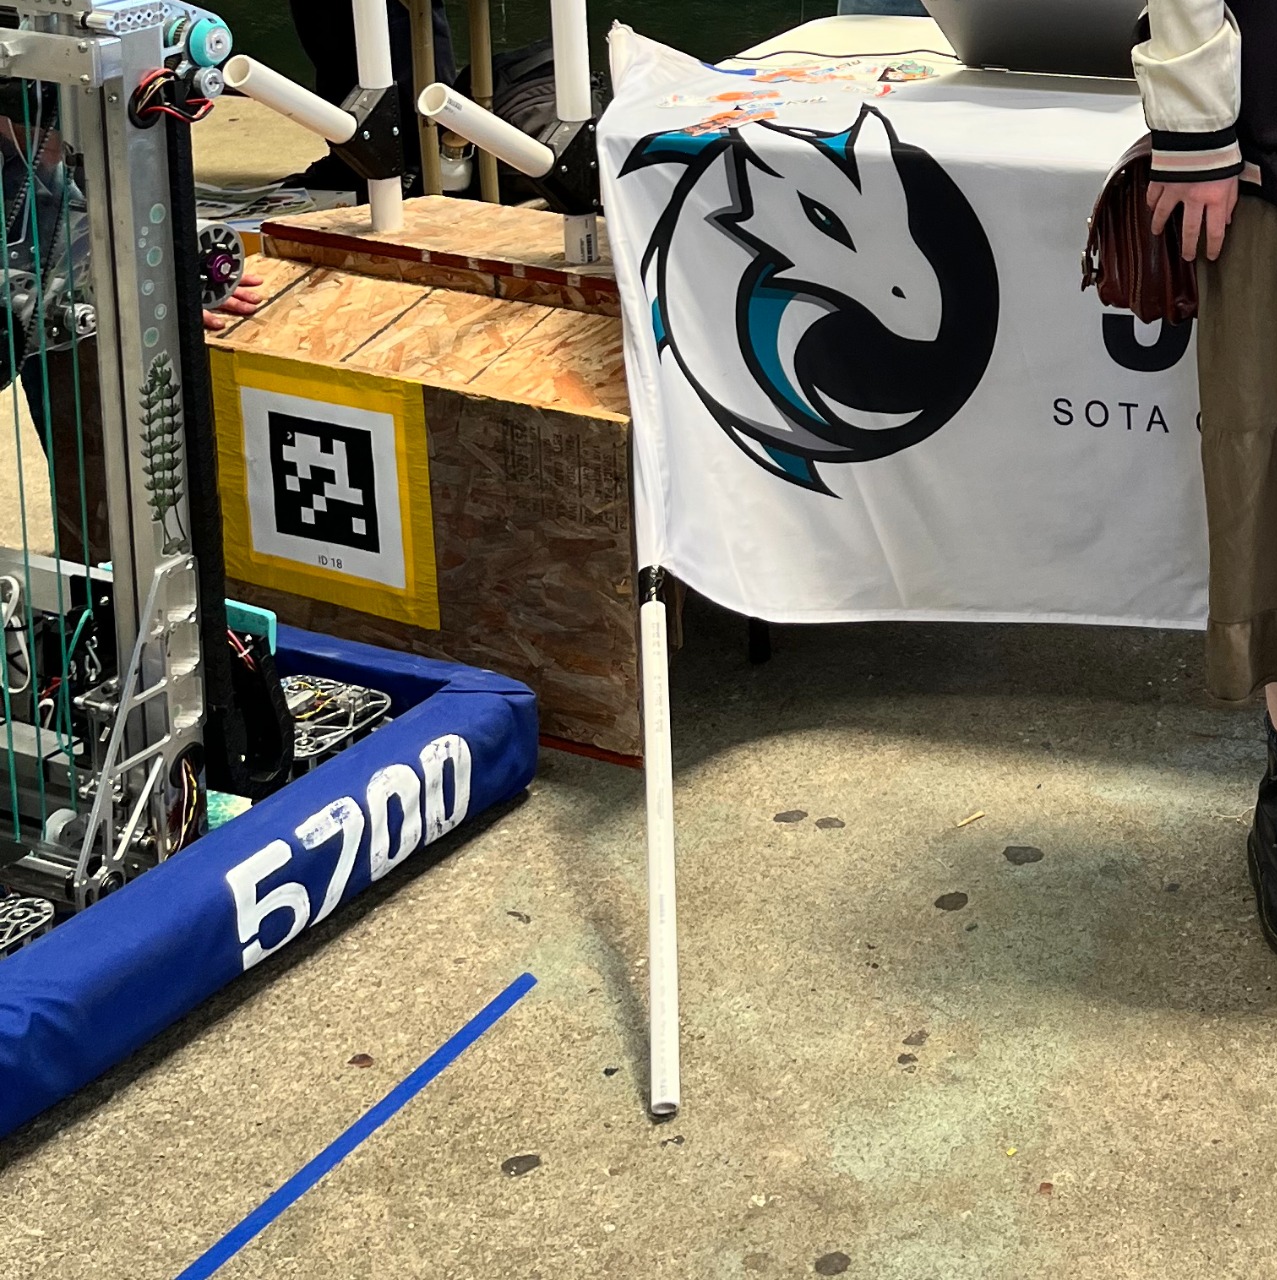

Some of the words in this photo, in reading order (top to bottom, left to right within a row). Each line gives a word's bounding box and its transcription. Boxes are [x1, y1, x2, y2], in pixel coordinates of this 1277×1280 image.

[1053, 398, 1169, 433] SOTA
[318, 555, 328, 566] ID
[331, 558, 343, 569] 18
[225, 734, 472, 970] 5700
